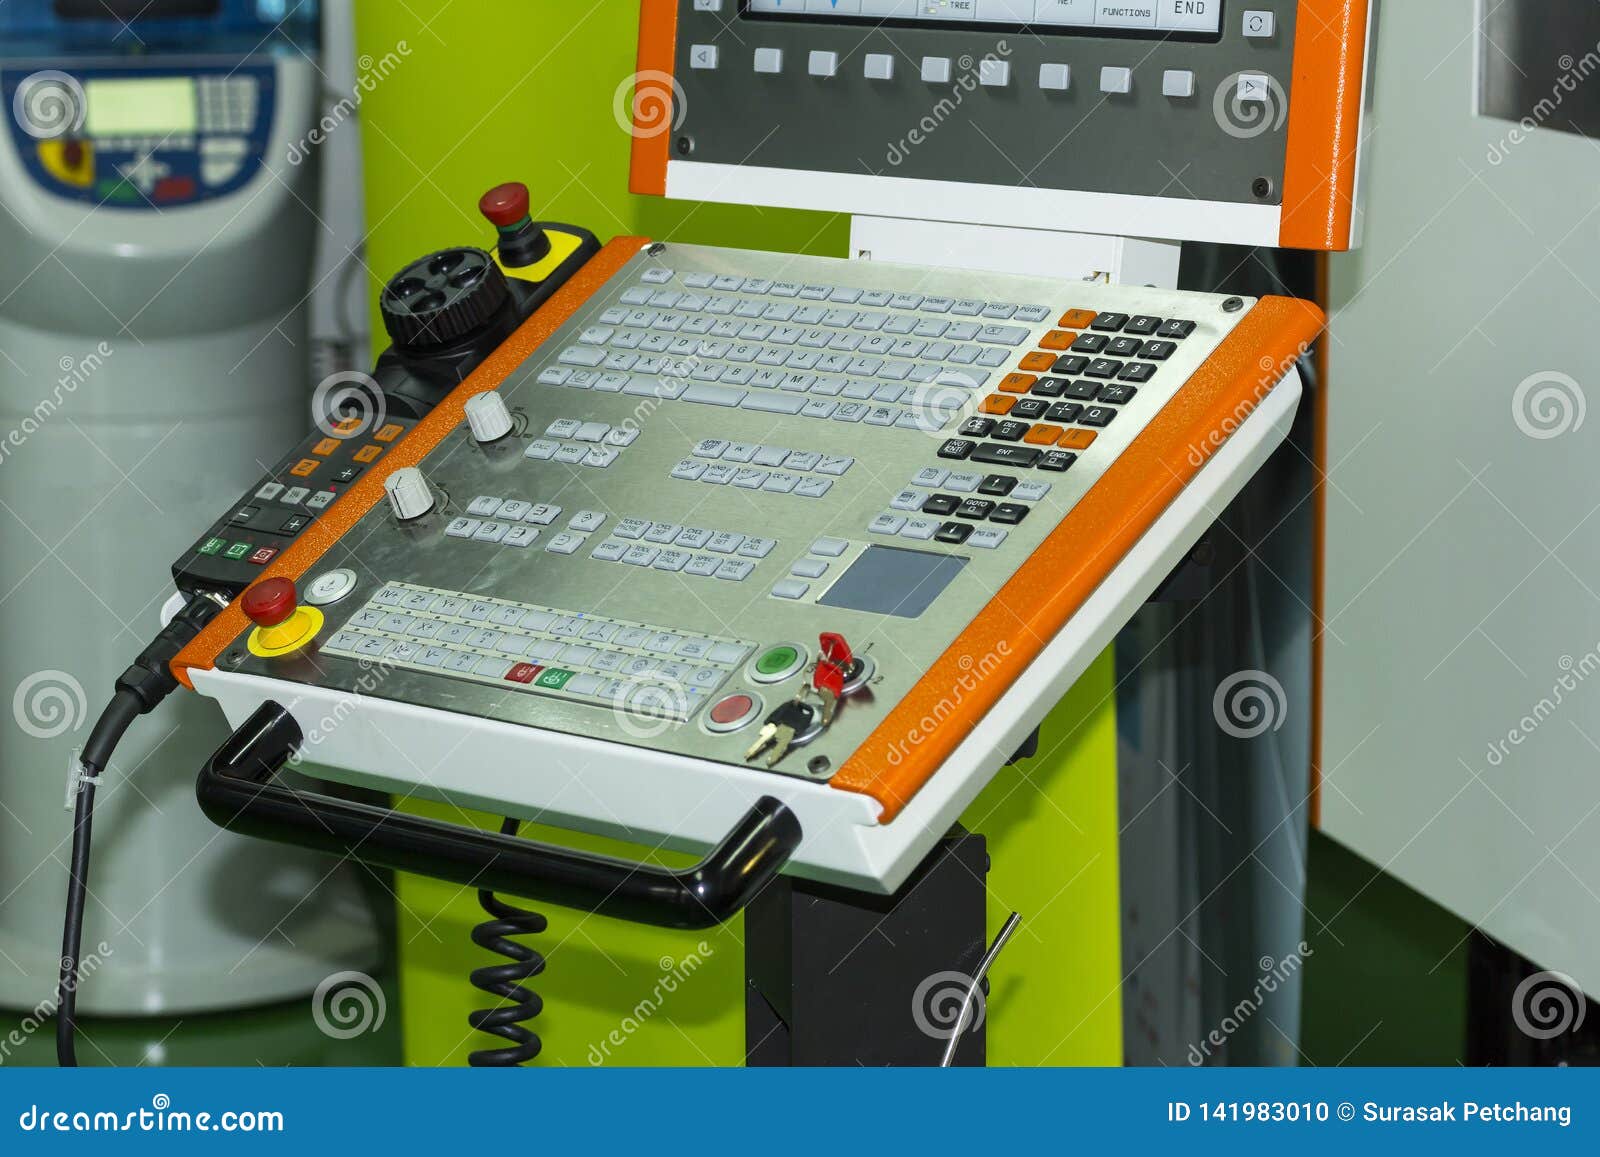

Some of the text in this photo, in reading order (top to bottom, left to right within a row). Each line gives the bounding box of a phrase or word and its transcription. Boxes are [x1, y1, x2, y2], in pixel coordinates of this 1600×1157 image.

[951, 1, 970, 10] TREE
[1174, 1, 1205, 15] END
[1102, 7, 1151, 18] FUNCTIONS
[950, 474, 973, 482] HOME
[966, 499, 988, 507] GOTO
[910, 520, 926, 528] END
[410, 594, 426, 604] Z+
[442, 599, 456, 608] Y+
[472, 604, 485, 613] V+
[359, 612, 375, 621] X-
[417, 622, 434, 631] X+
[337, 634, 352, 643] Y-
[364, 639, 380, 648] Z-
[425, 649, 439, 658] V-
